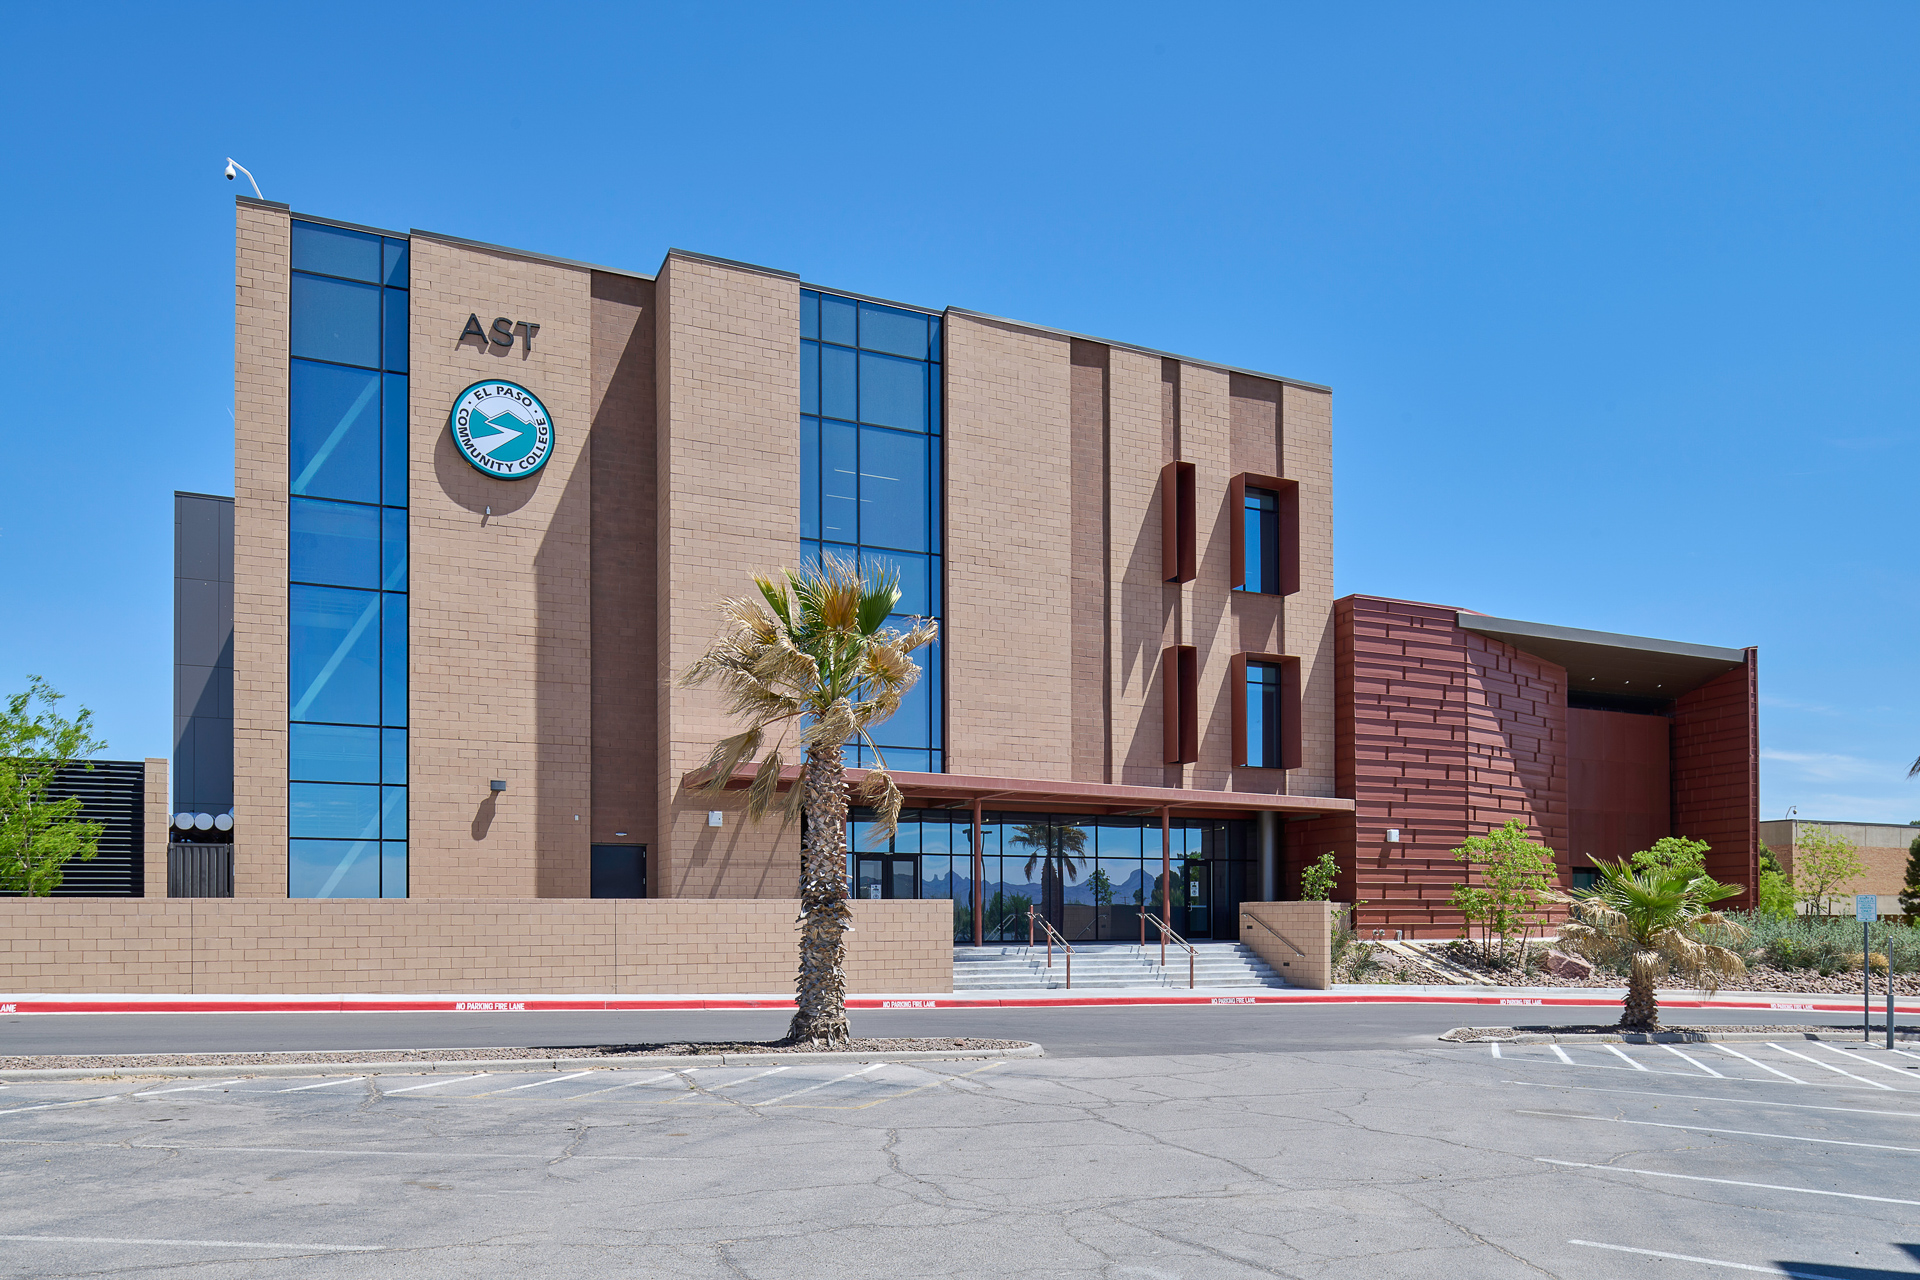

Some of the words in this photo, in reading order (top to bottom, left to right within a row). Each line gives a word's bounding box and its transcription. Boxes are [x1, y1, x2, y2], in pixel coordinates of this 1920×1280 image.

[459, 313, 540, 350] AST
[473, 387, 492, 400] EL
[496, 386, 532, 407] PASO
[458, 408, 514, 472] COMMUNITY
[519, 417, 548, 469] COLLEGE
[0, 1003, 16, 1013] ANE
[456, 1002, 465, 1010] NO
[467, 1002, 493, 1010] PARKING
[495, 1002, 508, 1010] FIRE
[509, 1002, 525, 1010] LANE
